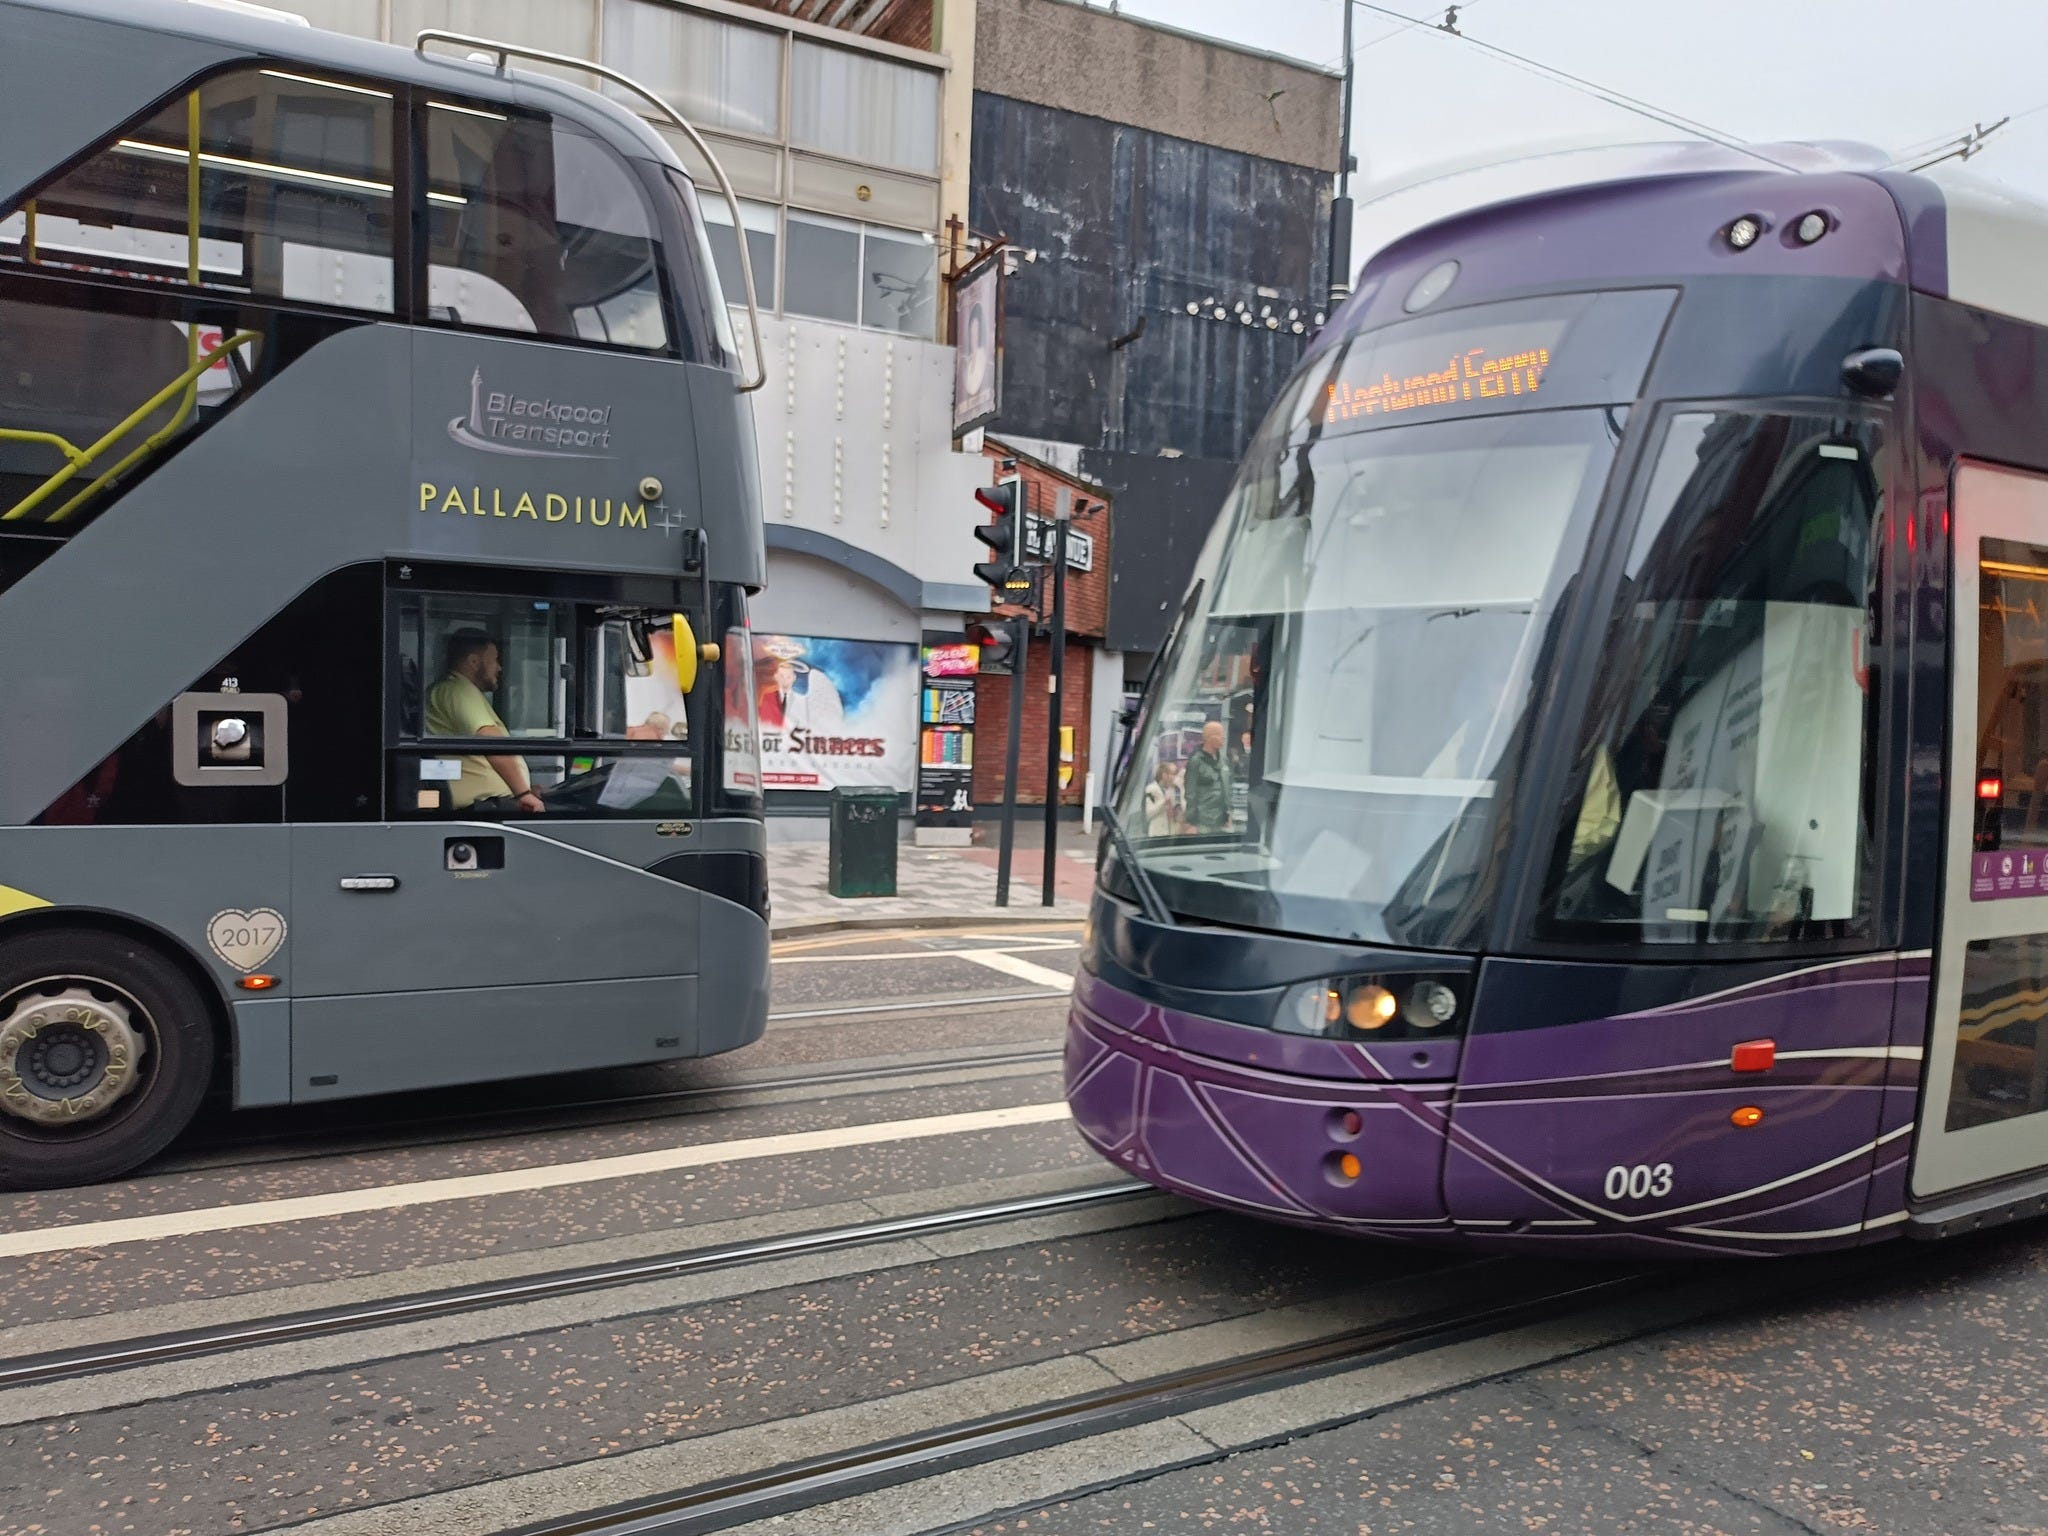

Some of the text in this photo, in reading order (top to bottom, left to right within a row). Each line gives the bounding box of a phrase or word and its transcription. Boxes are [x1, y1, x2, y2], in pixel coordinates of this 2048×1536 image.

[487, 392, 612, 425] Blackpool
[488, 416, 611, 448] Transport
[419, 482, 648, 529] PALLADIUM
[222, 677, 238, 688] 413
[762, 733, 783, 753] or
[789, 727, 886, 757] Sinners
[222, 927, 276, 948] 2017
[1604, 1162, 1674, 1200] 003
